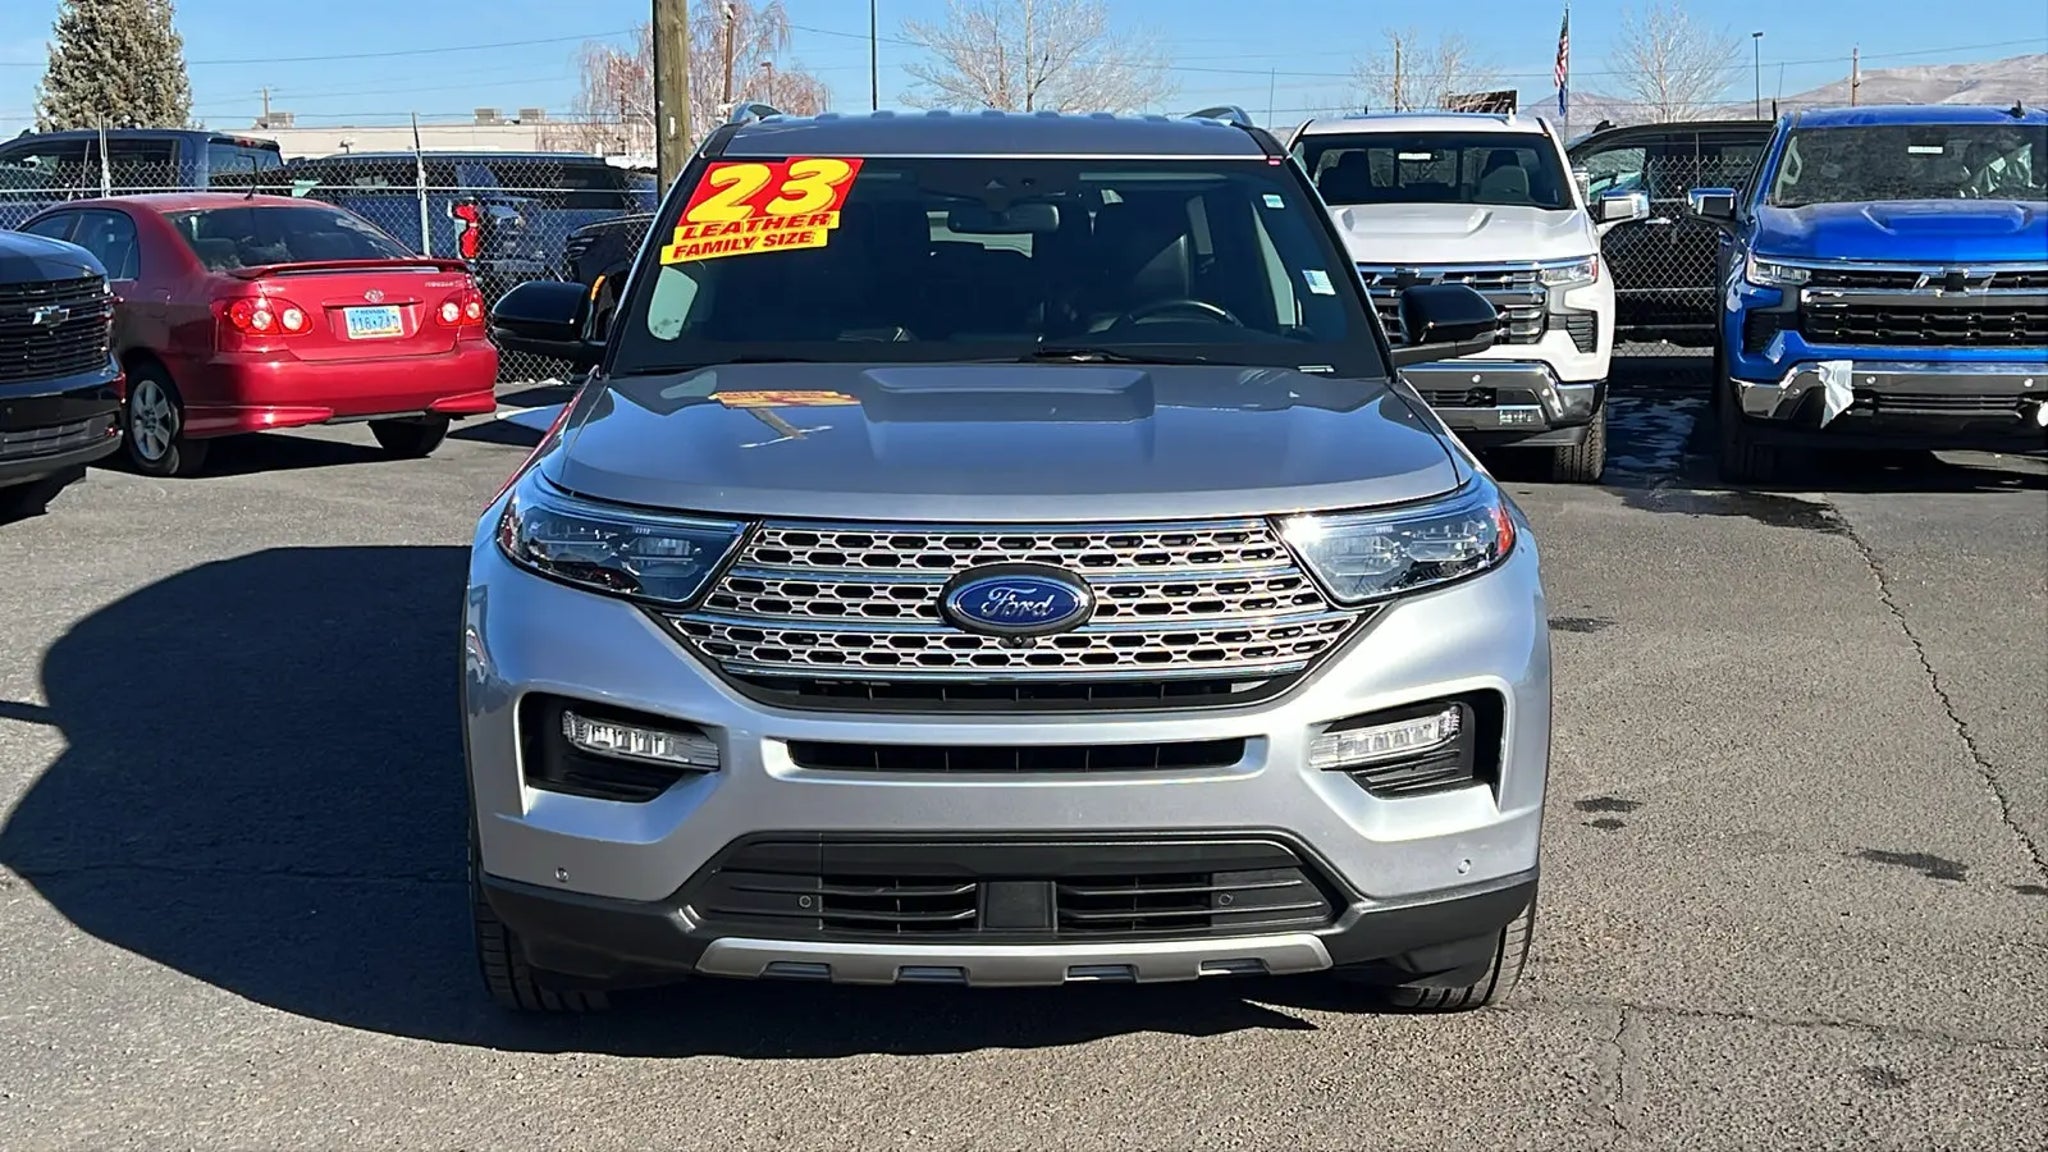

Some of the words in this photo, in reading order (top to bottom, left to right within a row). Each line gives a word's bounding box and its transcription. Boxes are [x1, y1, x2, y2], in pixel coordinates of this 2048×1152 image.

[686, 158, 854, 223] 23
[681, 213, 831, 240] LEATHER
[672, 236, 759, 259] FAMILY
[762, 231, 815, 247] SIZE
[981, 586, 1055, 616] Ford
